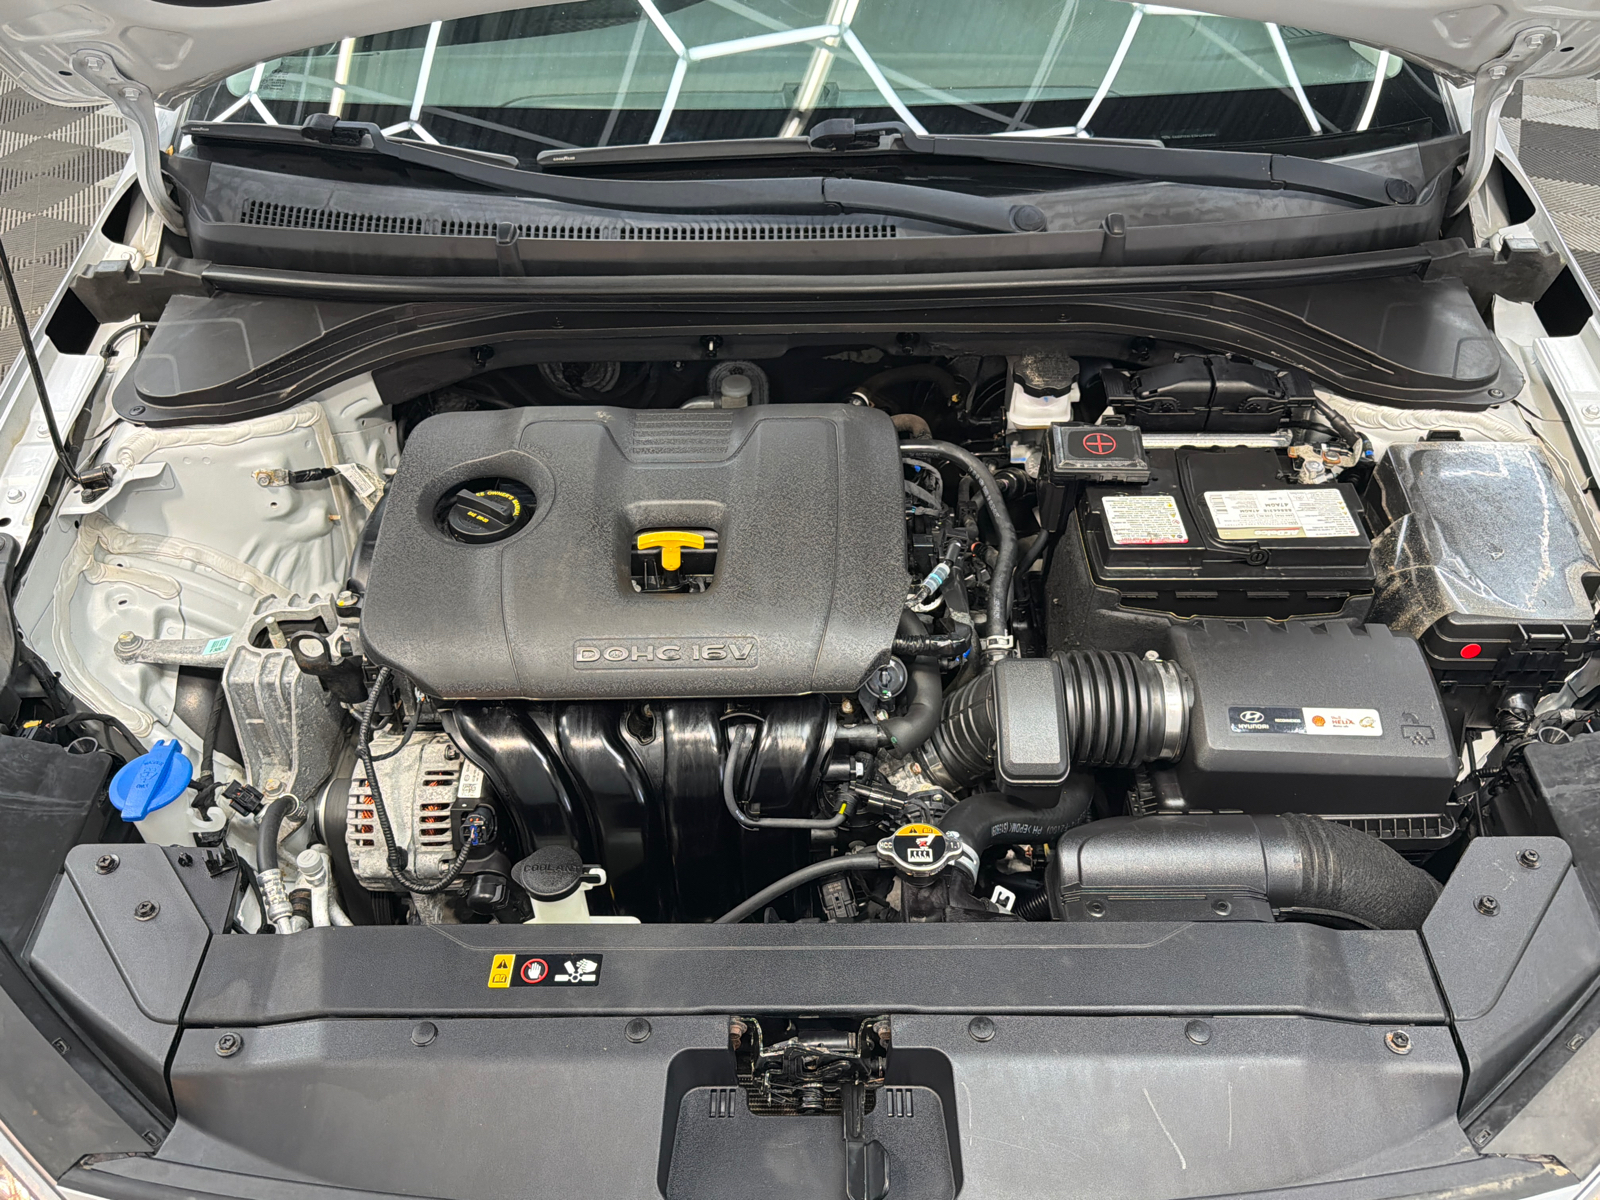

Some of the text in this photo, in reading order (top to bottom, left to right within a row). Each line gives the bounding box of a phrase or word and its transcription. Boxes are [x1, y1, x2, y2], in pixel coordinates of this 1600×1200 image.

[576, 643, 755, 663] DOHC 16V
[950, 841, 960, 849] 1.1
[523, 862, 581, 873] COOLANT
